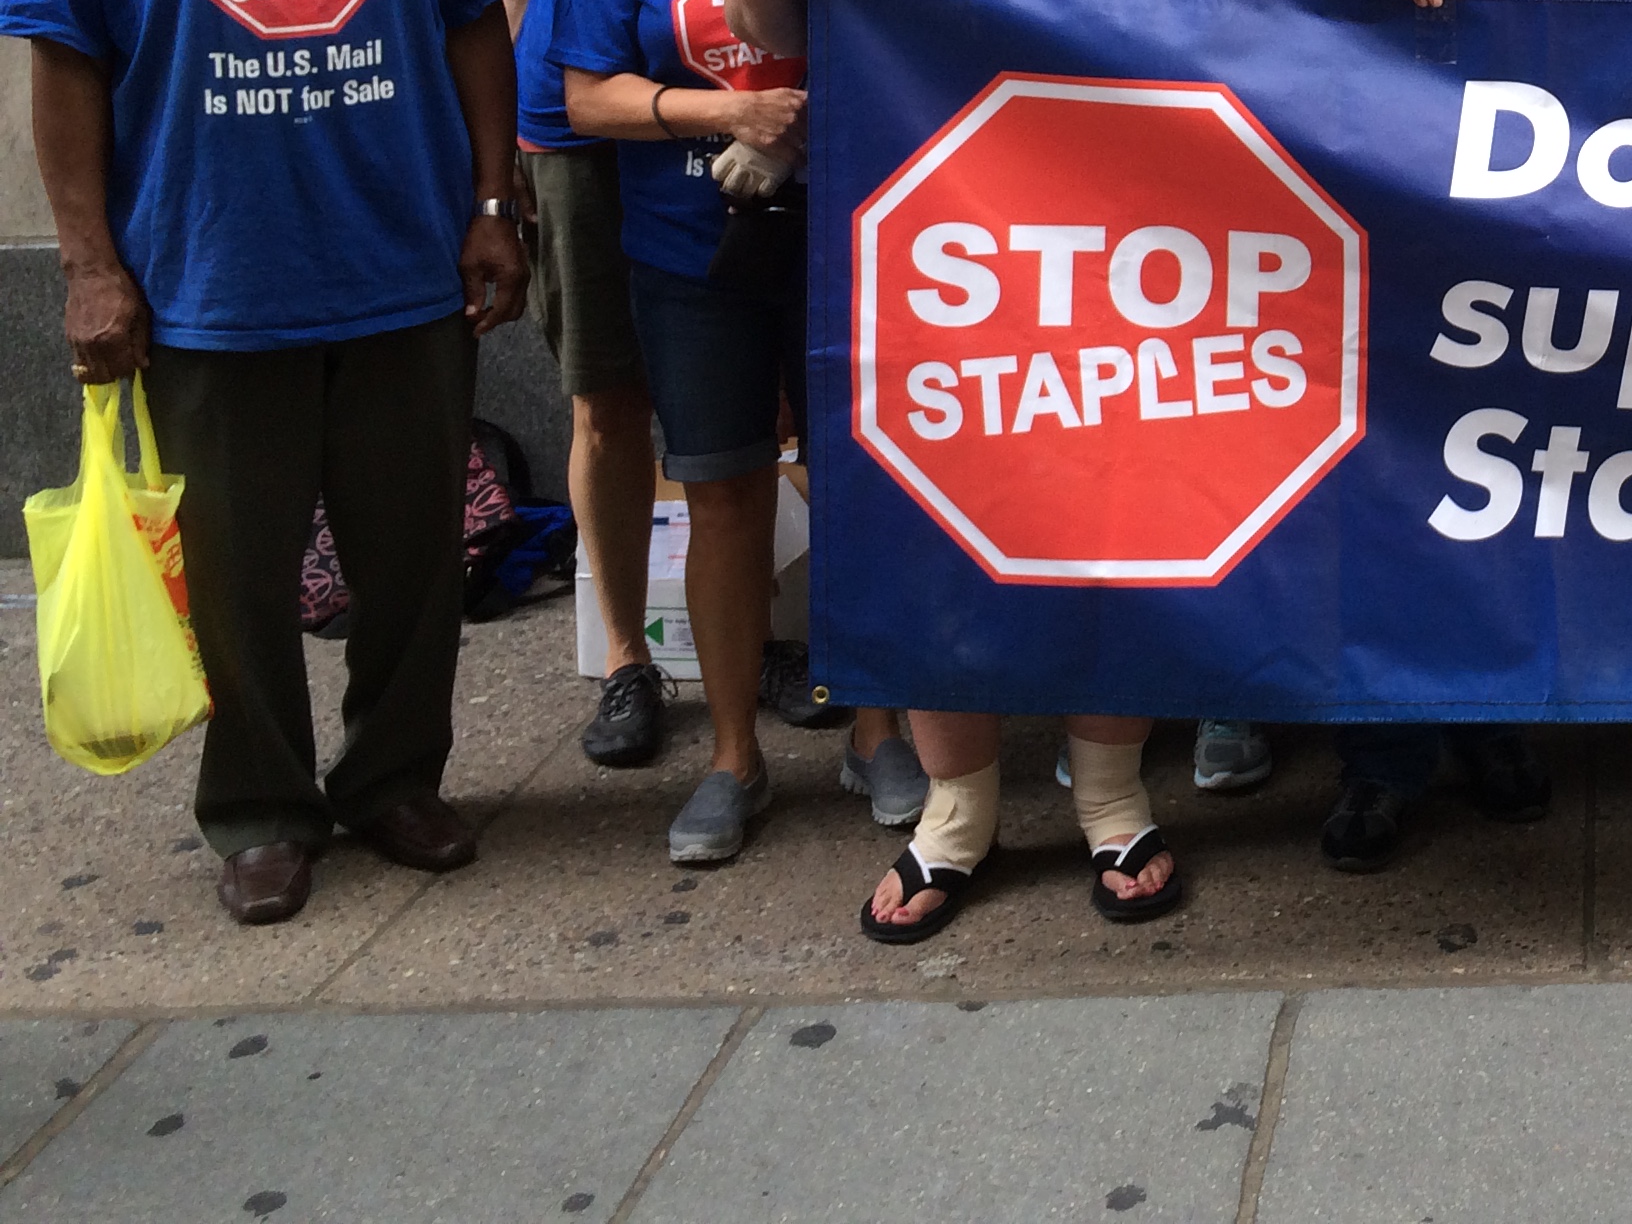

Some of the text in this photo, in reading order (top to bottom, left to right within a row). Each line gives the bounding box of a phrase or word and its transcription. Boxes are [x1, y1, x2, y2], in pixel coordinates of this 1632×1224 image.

[209, 39, 383, 79] The U.S. Mail
[204, 77, 395, 116] Is NOT for Sale
[686, 150, 706, 177] Is
[906, 221, 1313, 329] STOP
[906, 329, 1308, 441] STAPLES
